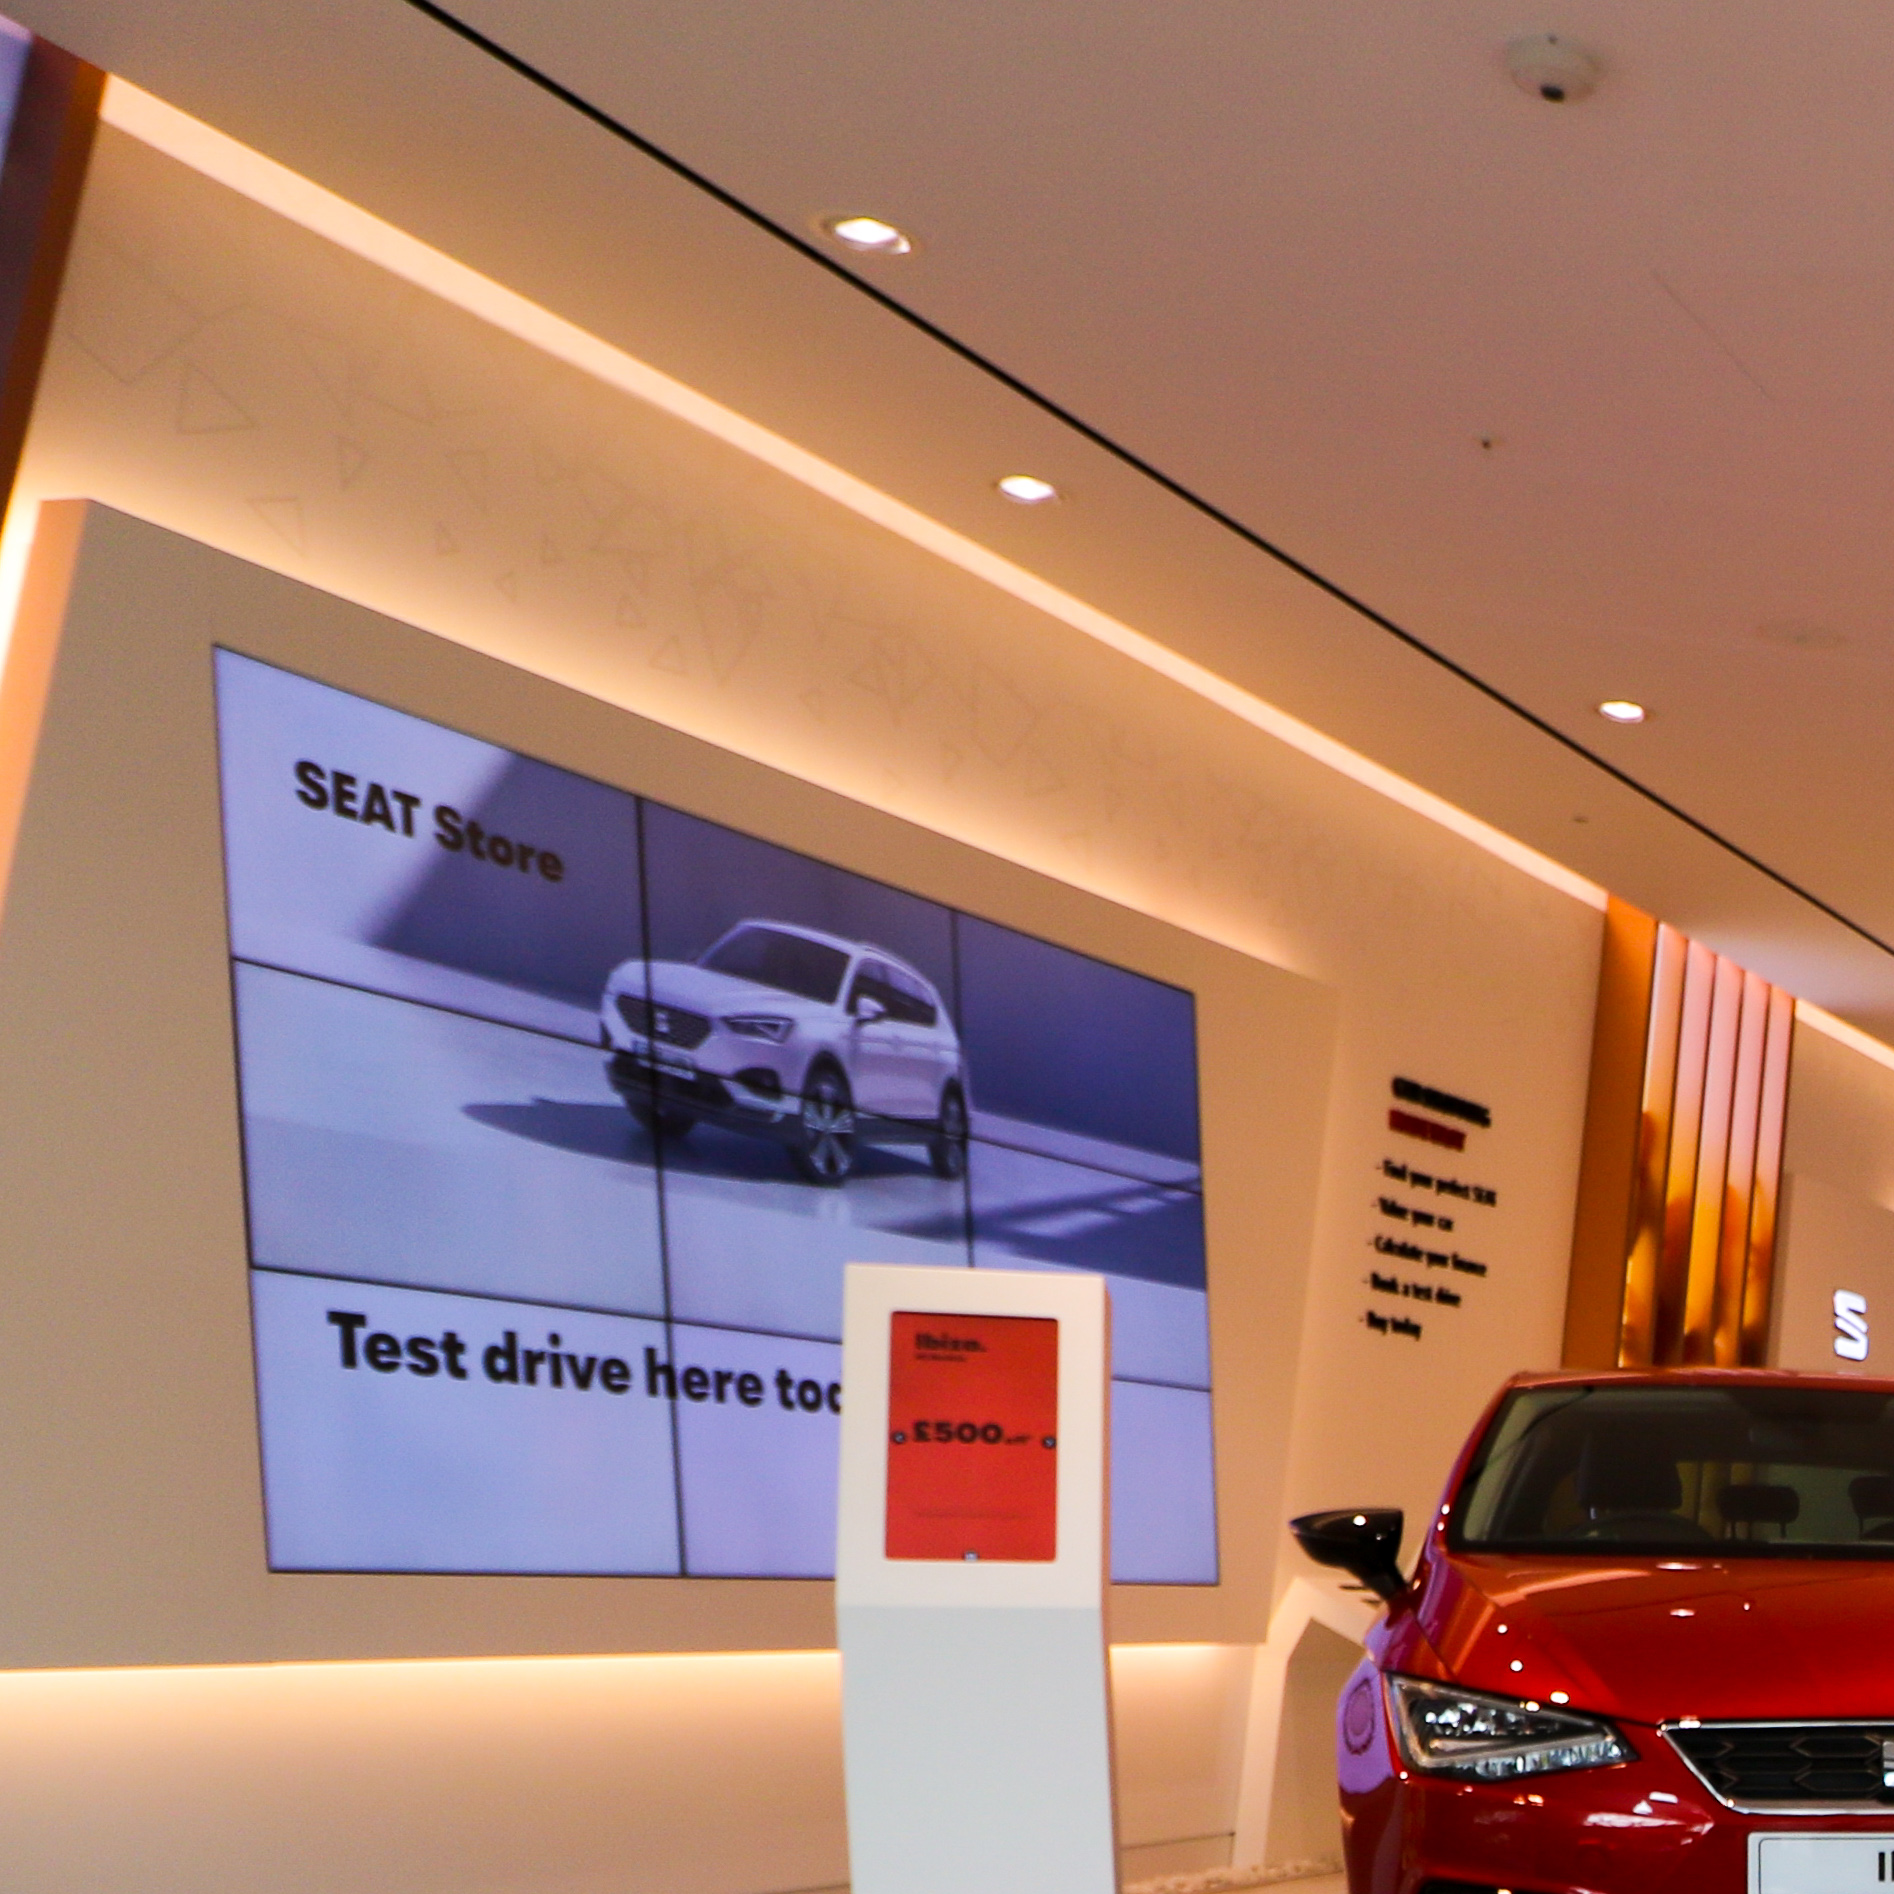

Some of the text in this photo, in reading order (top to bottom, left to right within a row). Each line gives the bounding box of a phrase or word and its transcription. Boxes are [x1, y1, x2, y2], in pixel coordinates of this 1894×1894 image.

[293, 759, 565, 883] SEAT Store
[327, 1310, 468, 1381] Test
[483, 1331, 632, 1395] drive
[644, 1346, 764, 1408] here
[914, 1420, 1004, 1444] £500
